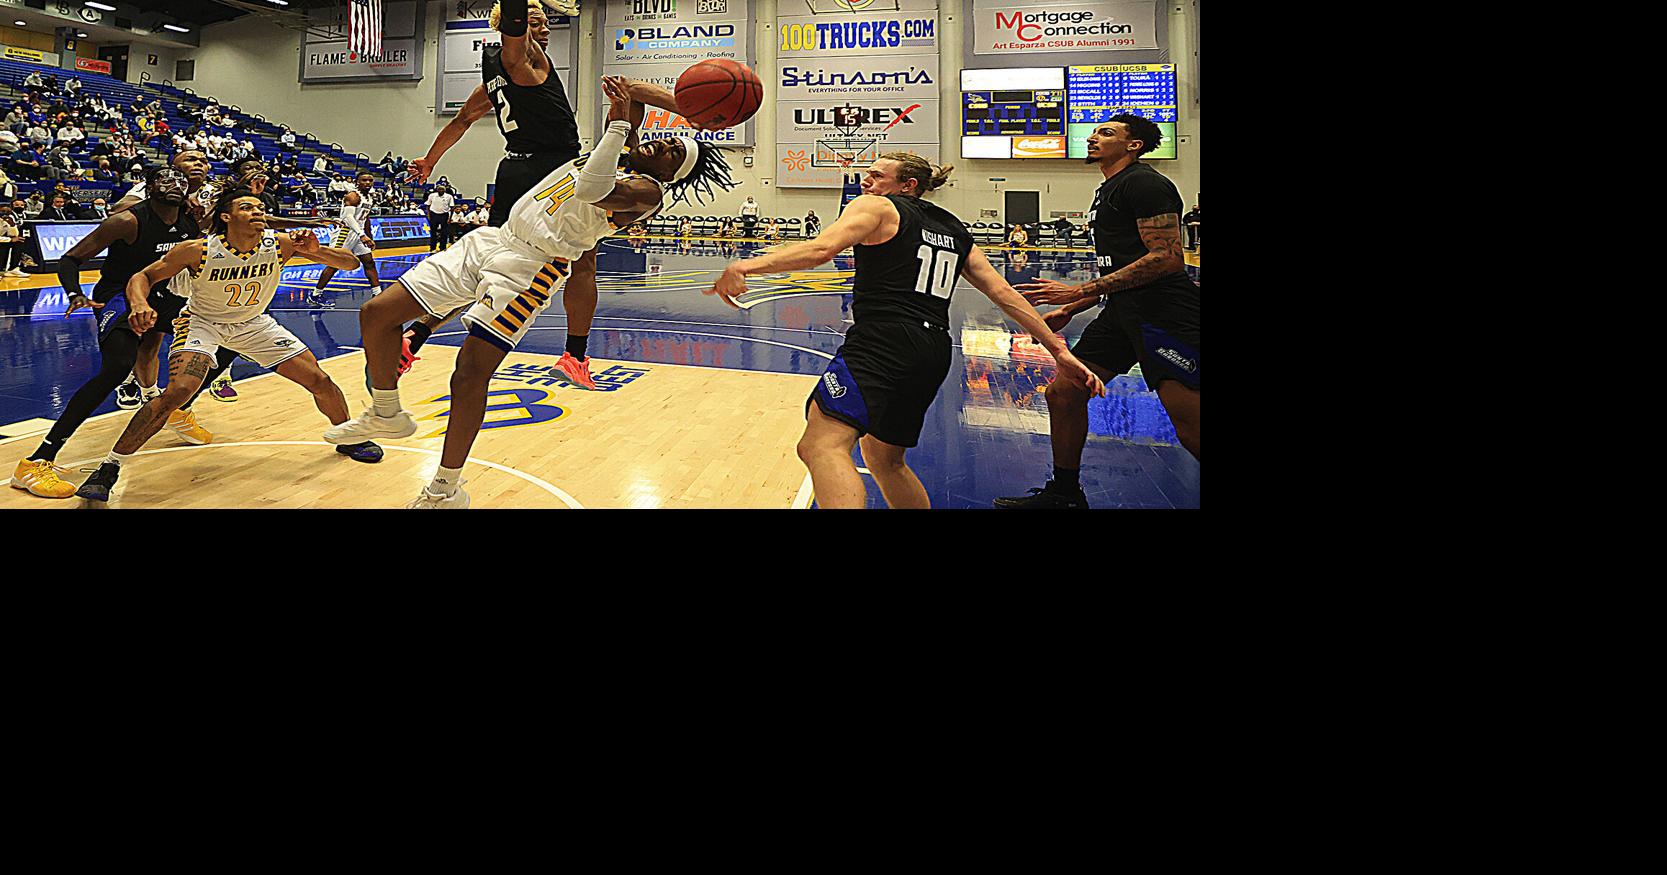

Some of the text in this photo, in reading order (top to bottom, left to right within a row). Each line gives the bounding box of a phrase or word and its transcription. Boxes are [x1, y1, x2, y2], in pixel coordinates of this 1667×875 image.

[995, 11, 1094, 29] Mortgage
[637, 24, 735, 40] BLAND
[781, 19, 935, 51] 100TRUCKS.COM
[1017, 22, 1132, 42] Connection
[648, 39, 722, 49] COMPANY
[1009, 42, 1046, 50] Esparza
[1048, 40, 1074, 48] CSUB
[310, 53, 346, 65] FLAME
[653, 52, 698, 61] Conditioning
[782, 66, 933, 87] Stinson's
[496, 88, 518, 133] 2
[795, 105, 917, 127] ULREX
[915, 244, 959, 299] 10
[224, 281, 262, 308] 22
